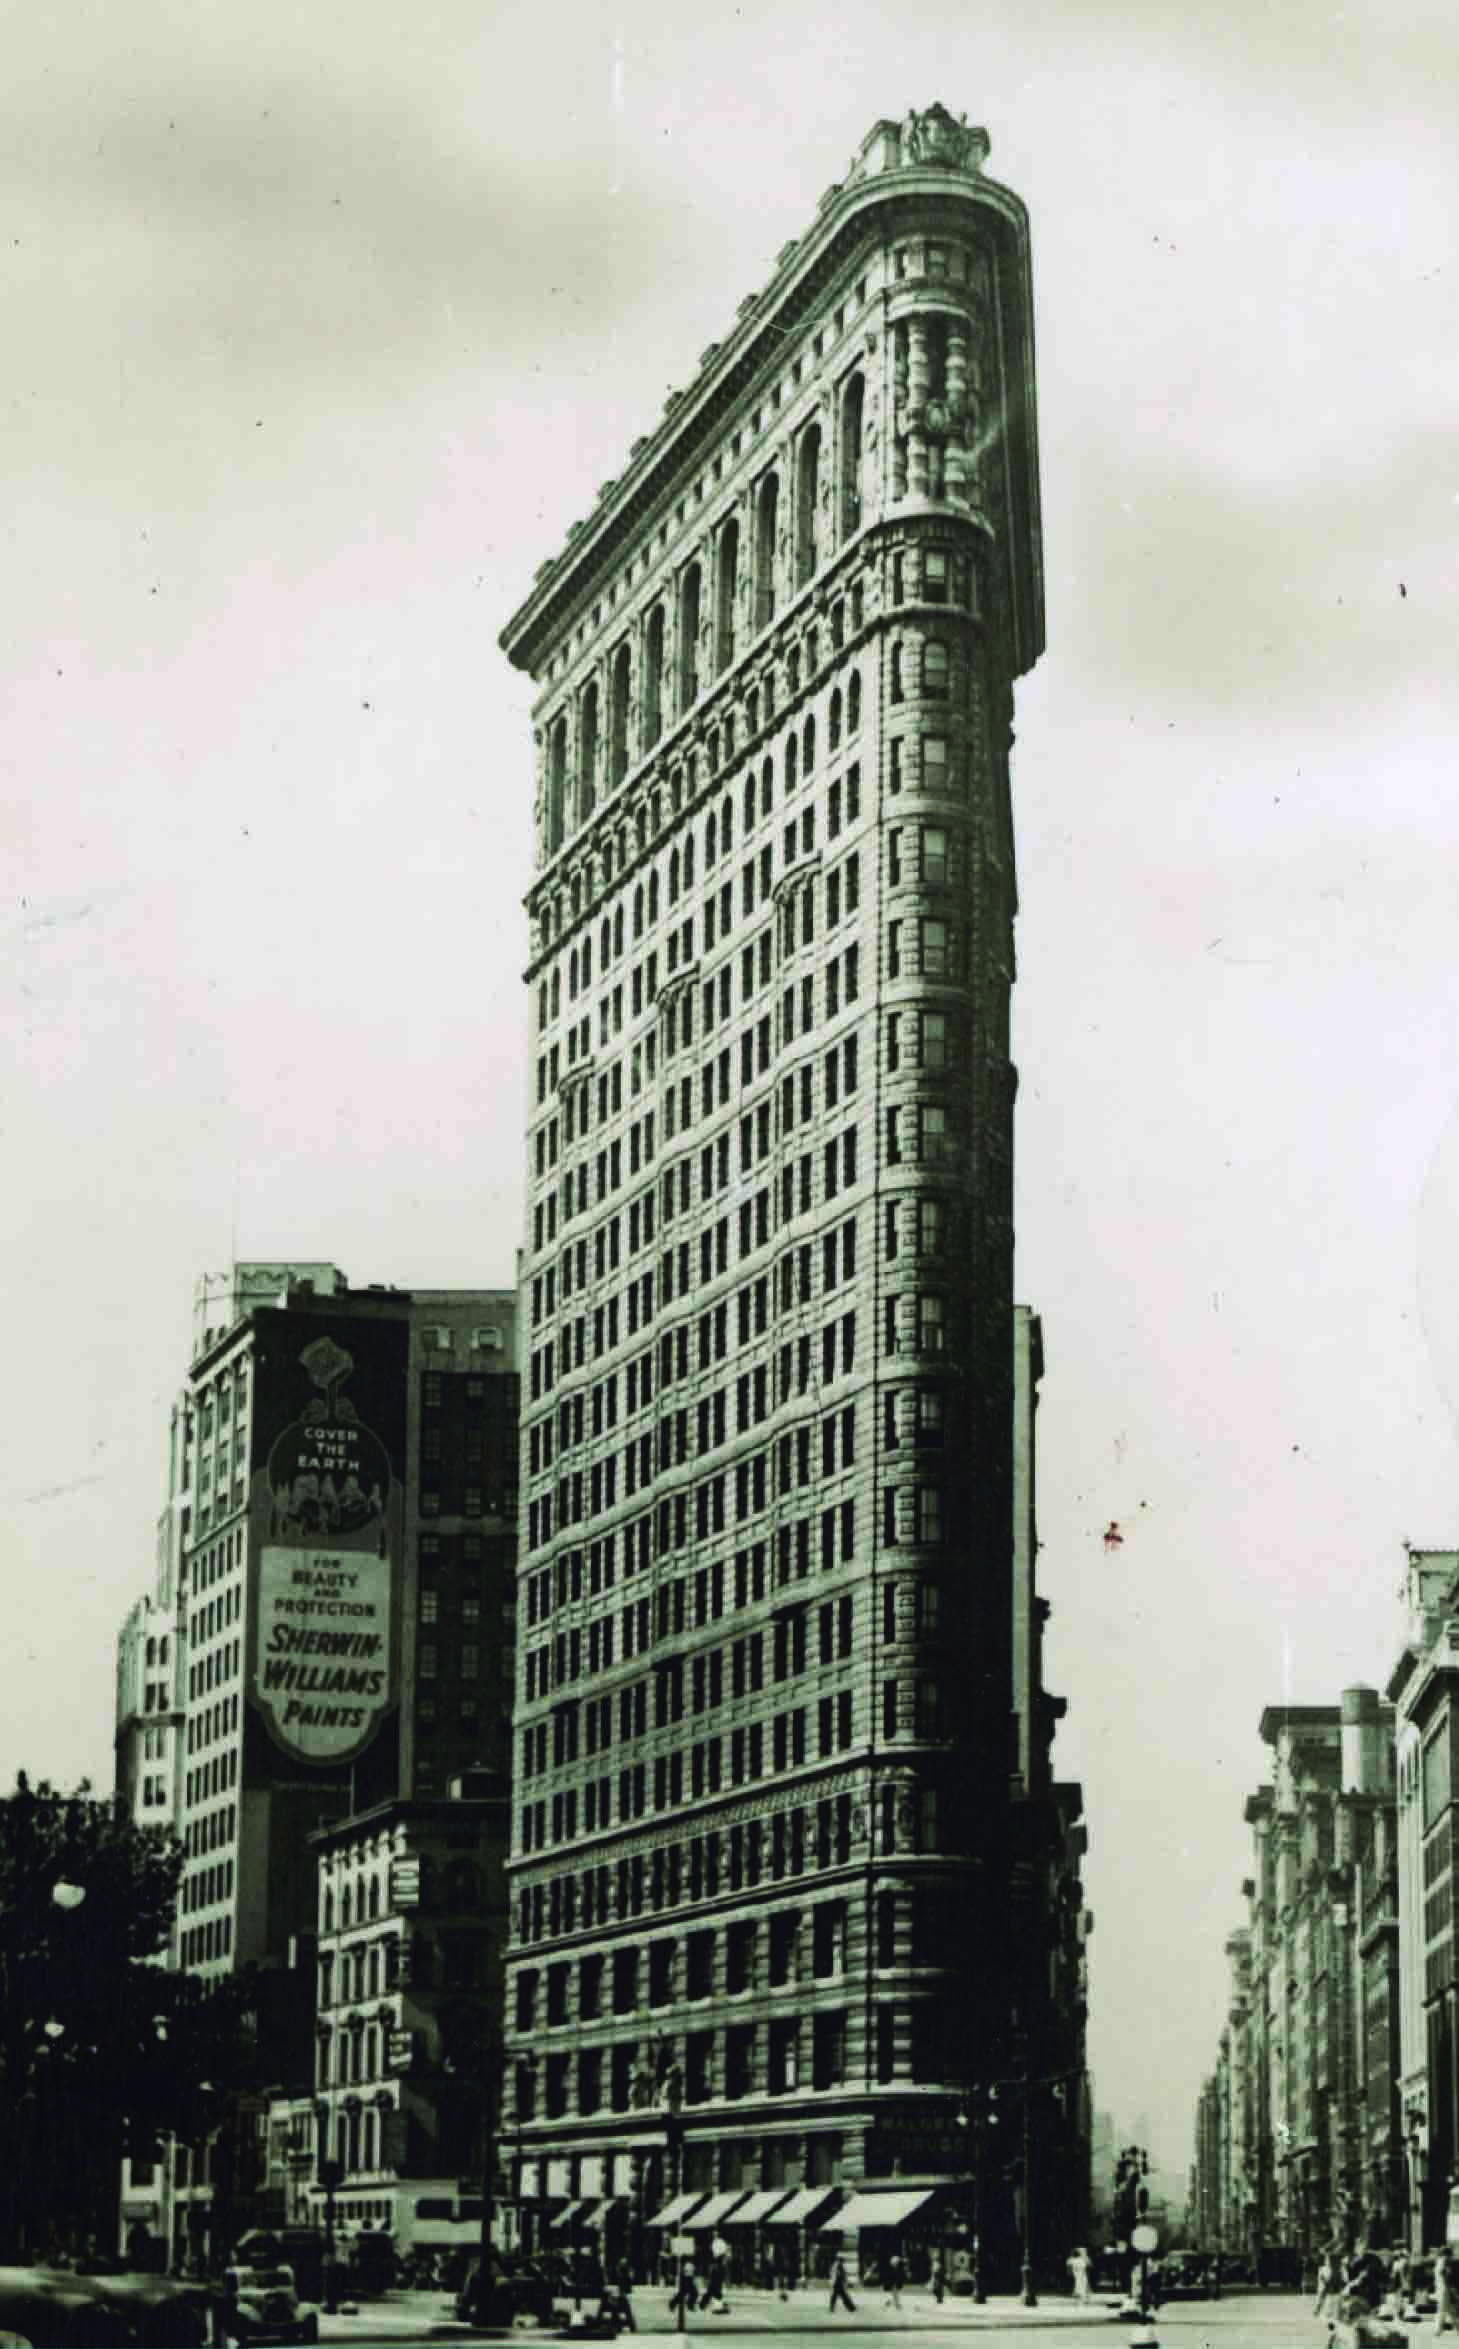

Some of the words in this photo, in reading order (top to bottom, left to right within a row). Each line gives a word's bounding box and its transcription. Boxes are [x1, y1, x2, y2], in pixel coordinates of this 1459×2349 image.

[304, 1427, 358, 1441] COVER
[316, 1442, 345, 1456] THE
[297, 1455, 360, 1472] EARTH
[291, 1570, 359, 1588] BEAUTY
[274, 1599, 376, 1617] PROTECTION
[263, 1659, 385, 1695] WILLIAMS
[283, 1700, 366, 1727] PAINTS
